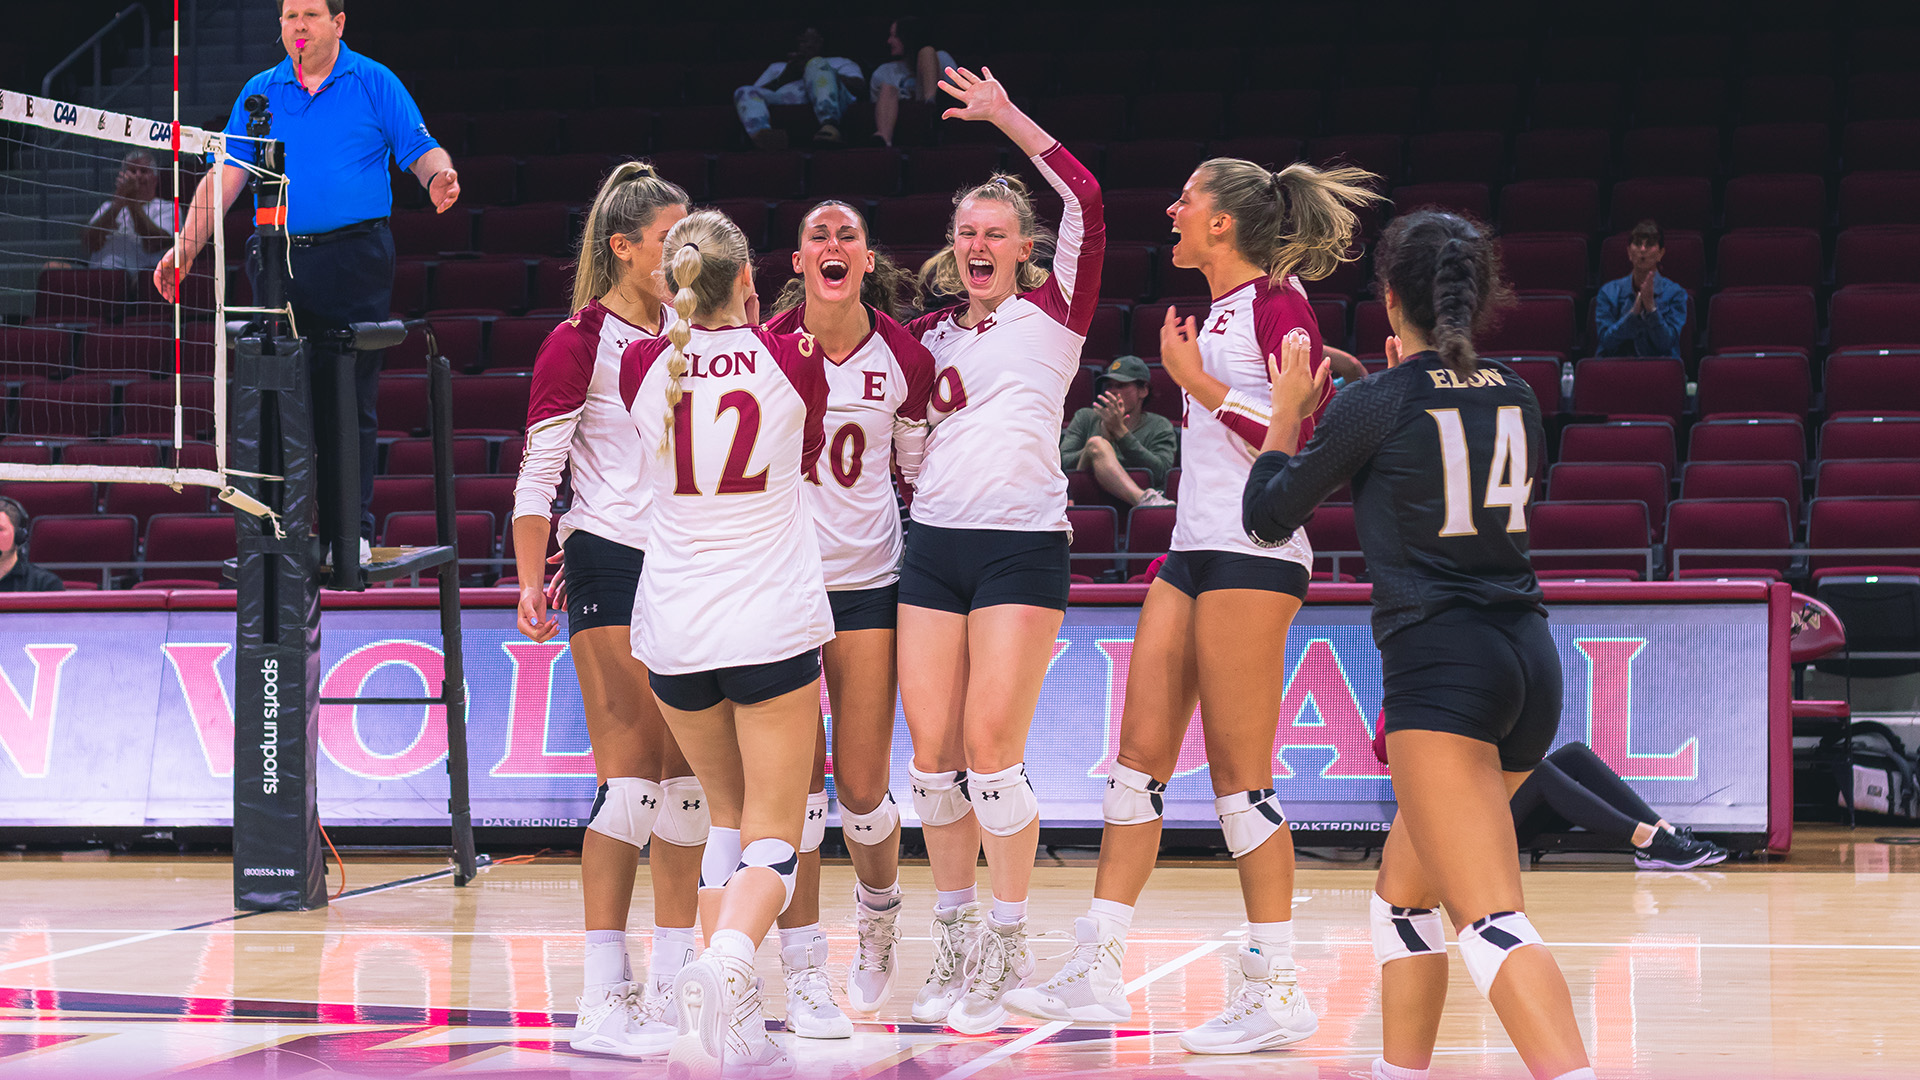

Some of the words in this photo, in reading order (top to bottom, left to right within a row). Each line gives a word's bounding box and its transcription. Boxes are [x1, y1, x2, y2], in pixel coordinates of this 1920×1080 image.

[53, 102, 78, 126] CAA
[1209, 309, 1235, 335] E
[861, 370, 887, 401] E
[673, 388, 770, 496] 12
[1424, 405, 1533, 537] 14
[261, 658, 280, 719] sports
[260, 721, 279, 794] imports
[482, 818, 579, 827] DAKTRONICS
[1289, 822, 1391, 832] DAKTRONICS
